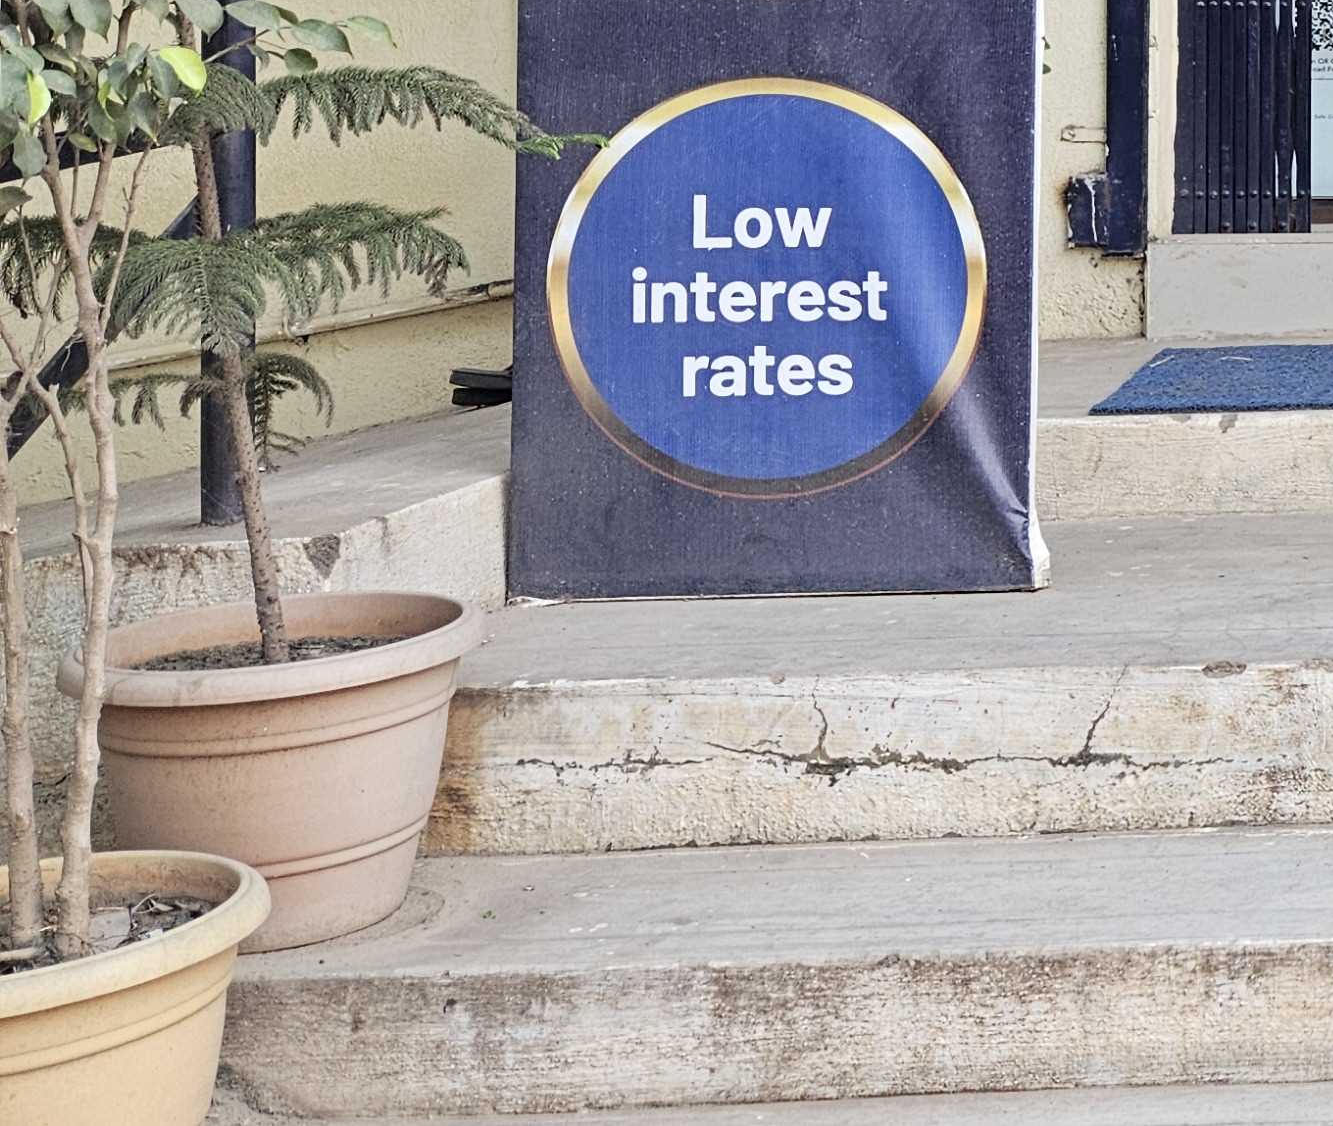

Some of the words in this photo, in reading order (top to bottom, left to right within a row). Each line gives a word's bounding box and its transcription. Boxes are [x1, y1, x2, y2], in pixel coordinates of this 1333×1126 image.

[692, 194, 833, 250] Low
[632, 266, 888, 324] interest
[681, 345, 854, 398] rates
